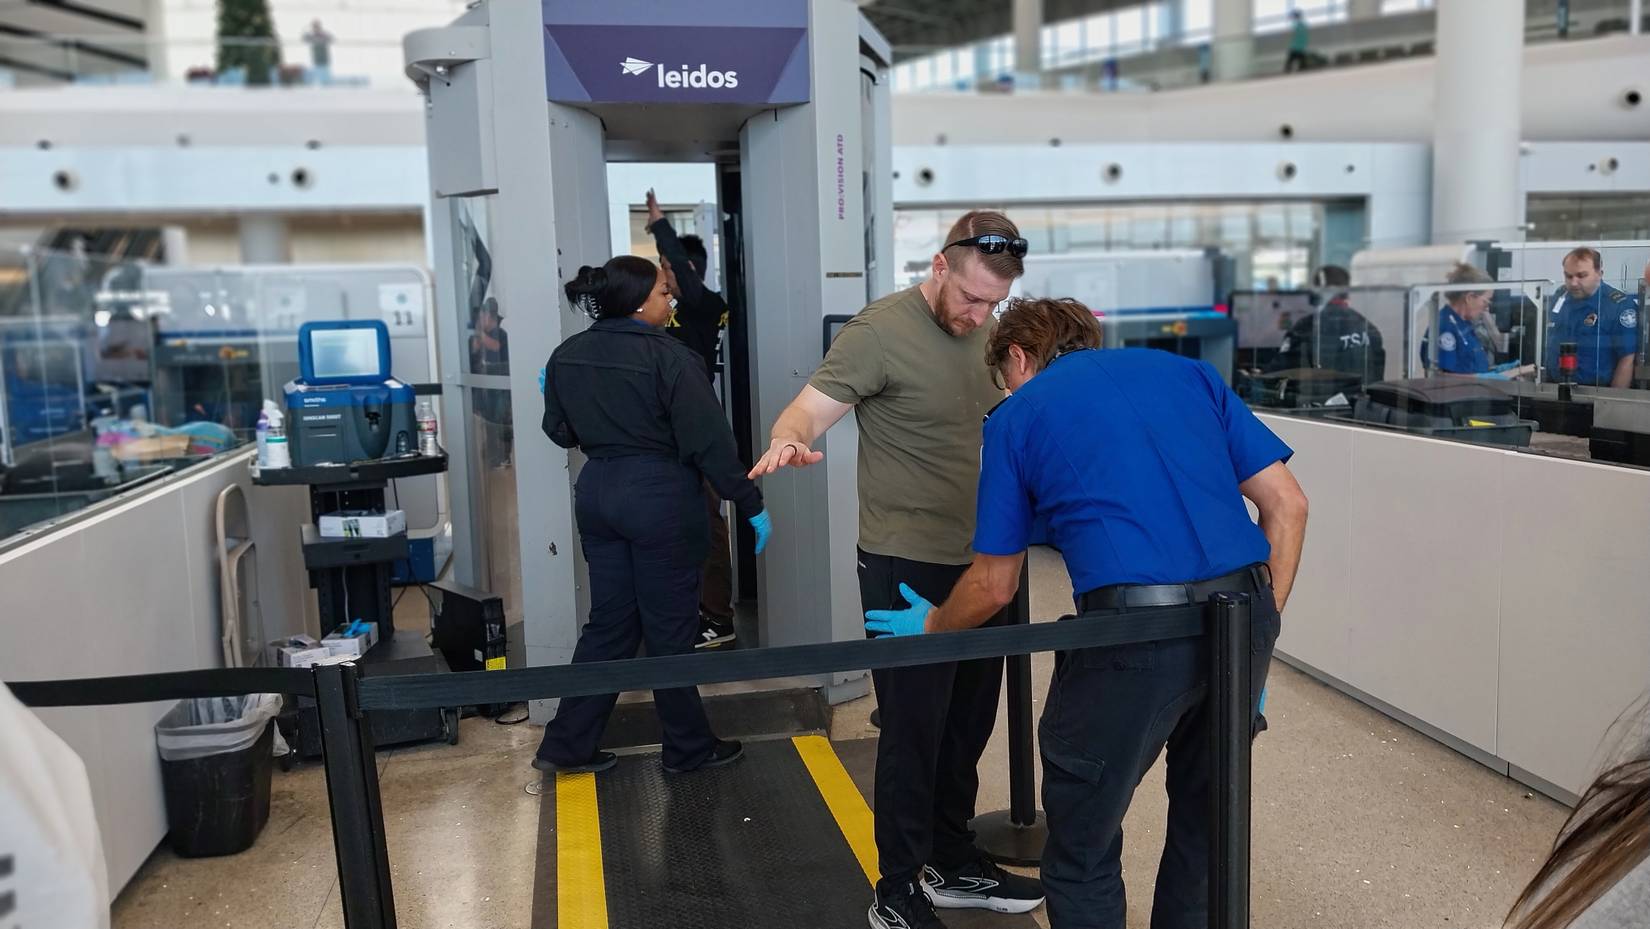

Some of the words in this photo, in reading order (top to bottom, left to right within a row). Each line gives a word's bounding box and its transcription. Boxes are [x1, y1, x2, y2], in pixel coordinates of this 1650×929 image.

[657, 63, 739, 89] leidos
[836, 133, 844, 156] ATD
[392, 310, 413, 327] 11
[1340, 331, 1370, 350] TSA
